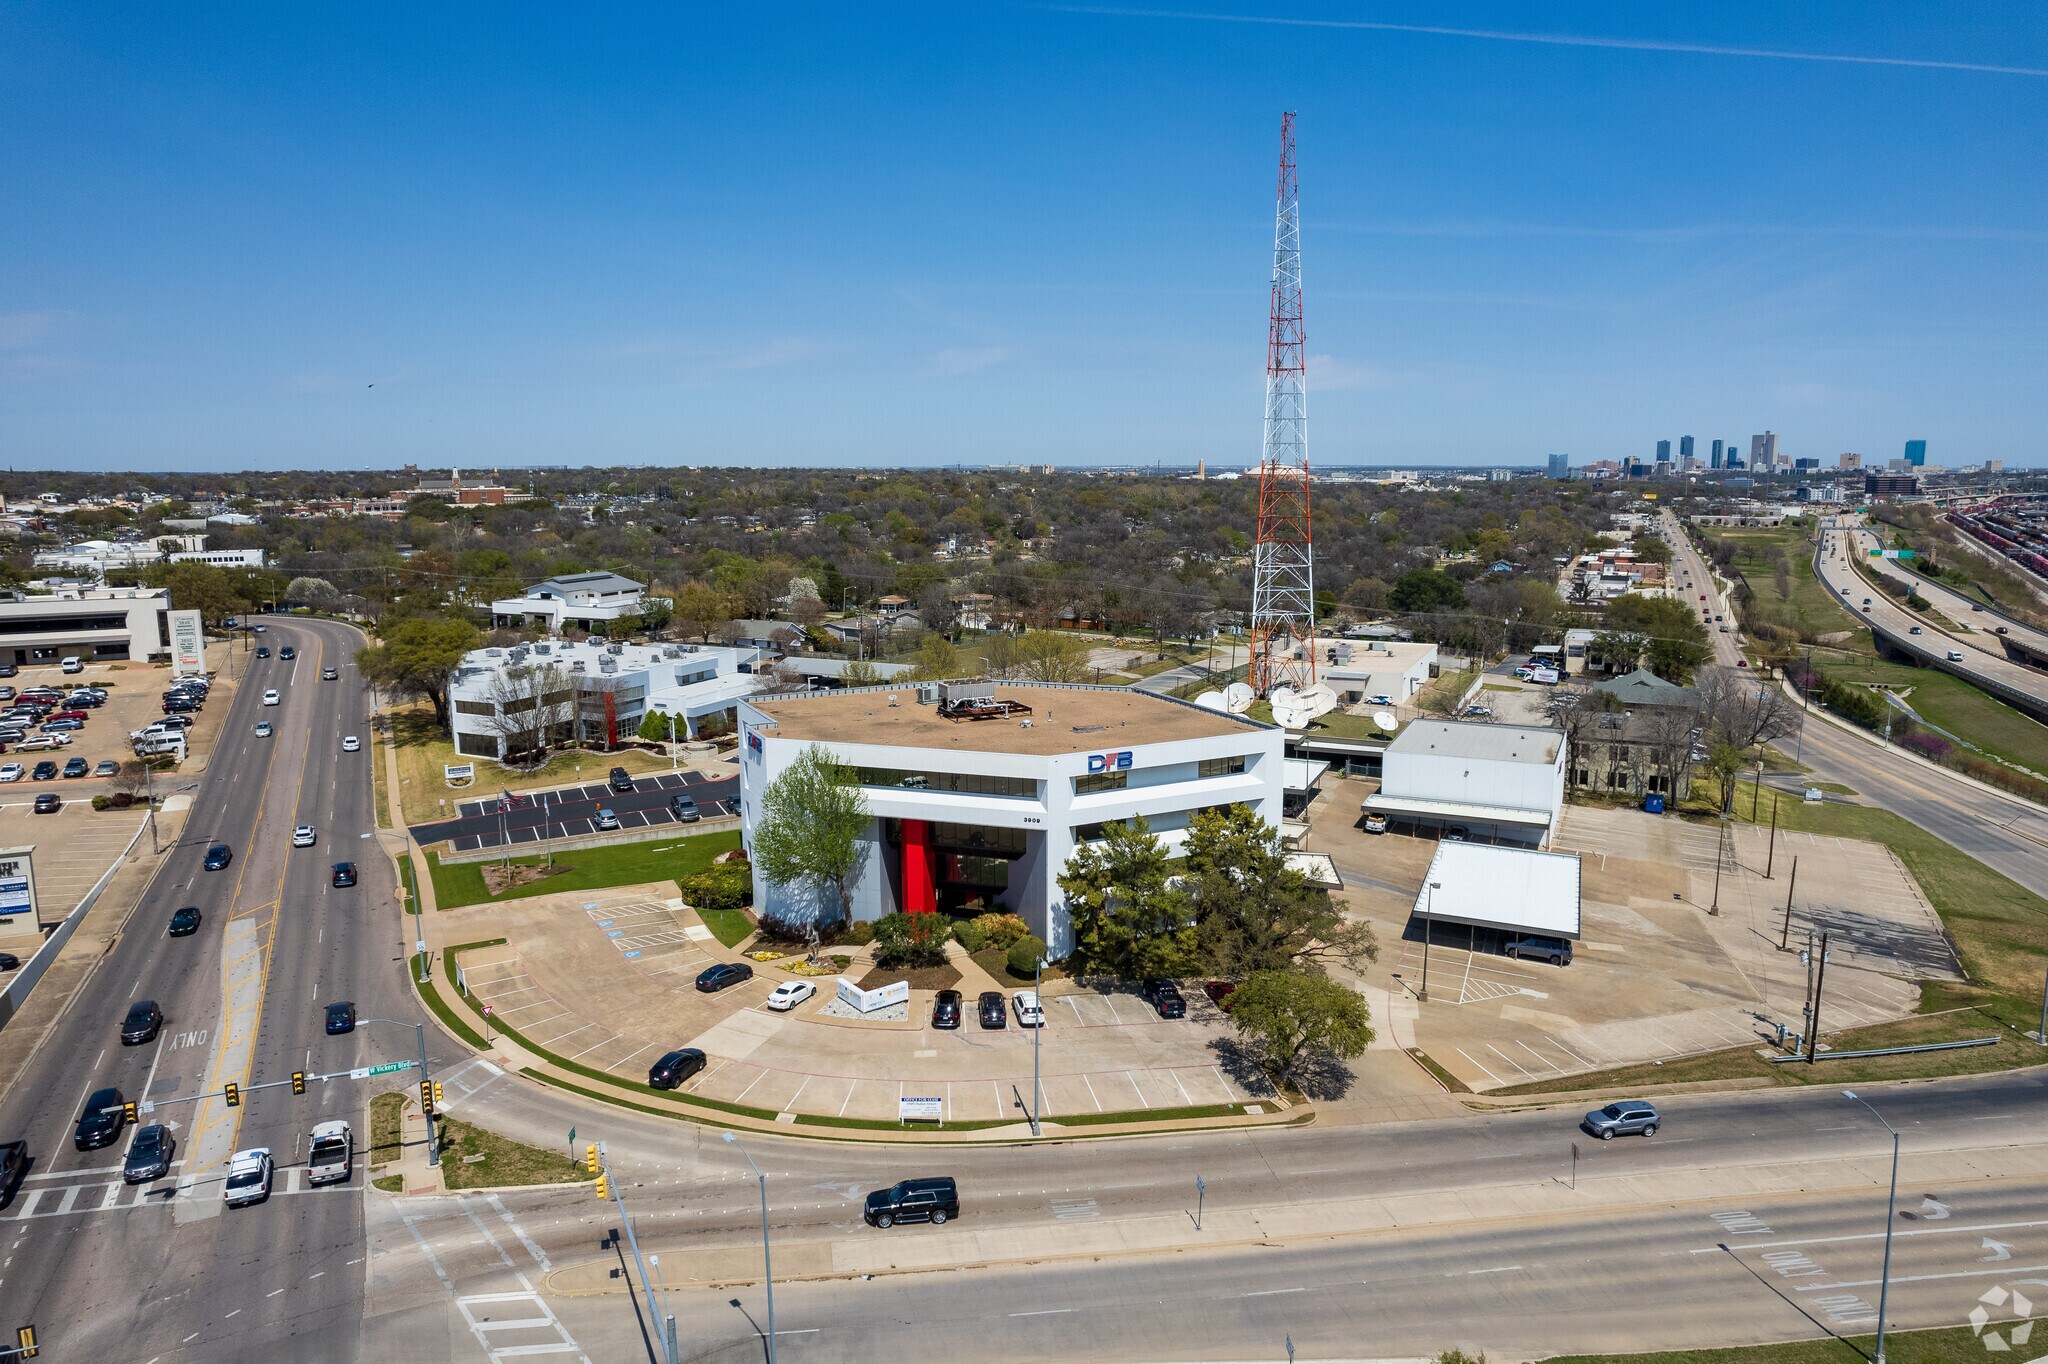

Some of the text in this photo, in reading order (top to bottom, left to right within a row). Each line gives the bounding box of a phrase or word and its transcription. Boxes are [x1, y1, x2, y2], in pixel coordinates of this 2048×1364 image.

[1088, 751, 1133, 773] DFB
[169, 1029, 208, 1051] ONLY
[376, 1063, 397, 1073] Vickery
[397, 1060, 411, 1069] Blvd
[1709, 1211, 1775, 1235] ONLY
[1760, 1251, 1829, 1278] ONLY
[1813, 1295, 1886, 1325] ONLY
